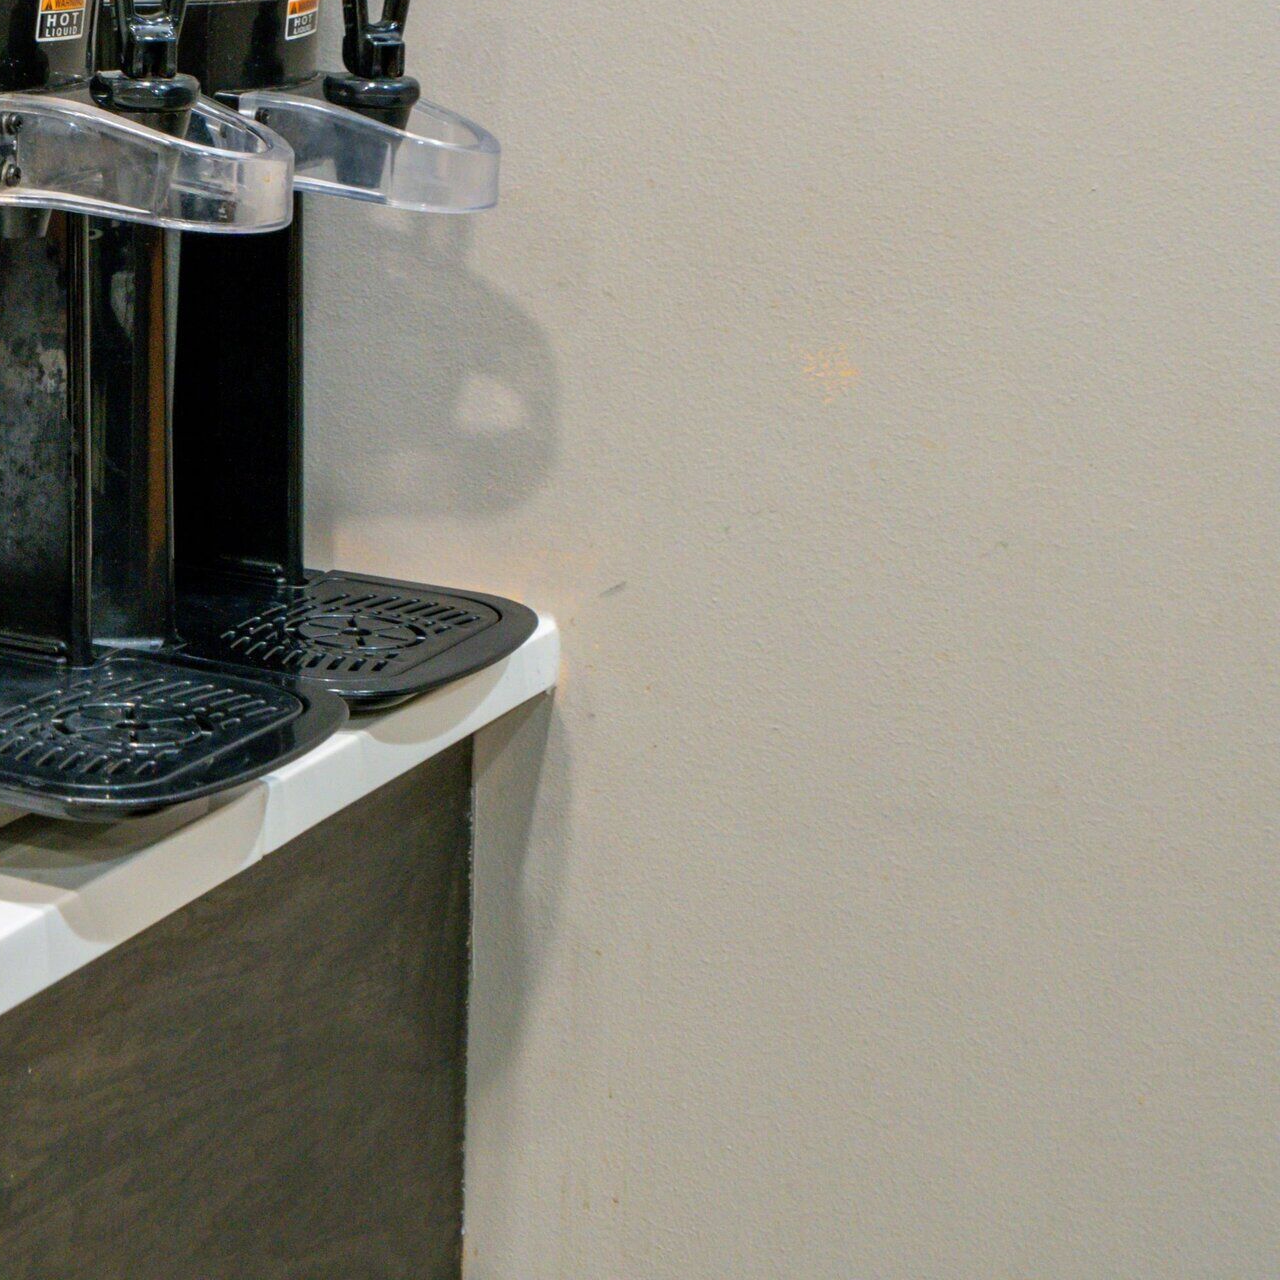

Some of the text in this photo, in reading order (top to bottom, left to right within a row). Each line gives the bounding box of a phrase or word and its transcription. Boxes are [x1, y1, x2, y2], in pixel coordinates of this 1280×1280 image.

[47, 12, 79, 27] HOT
[294, 14, 313, 28] HOT
[45, 26, 78, 38] LIQUID
